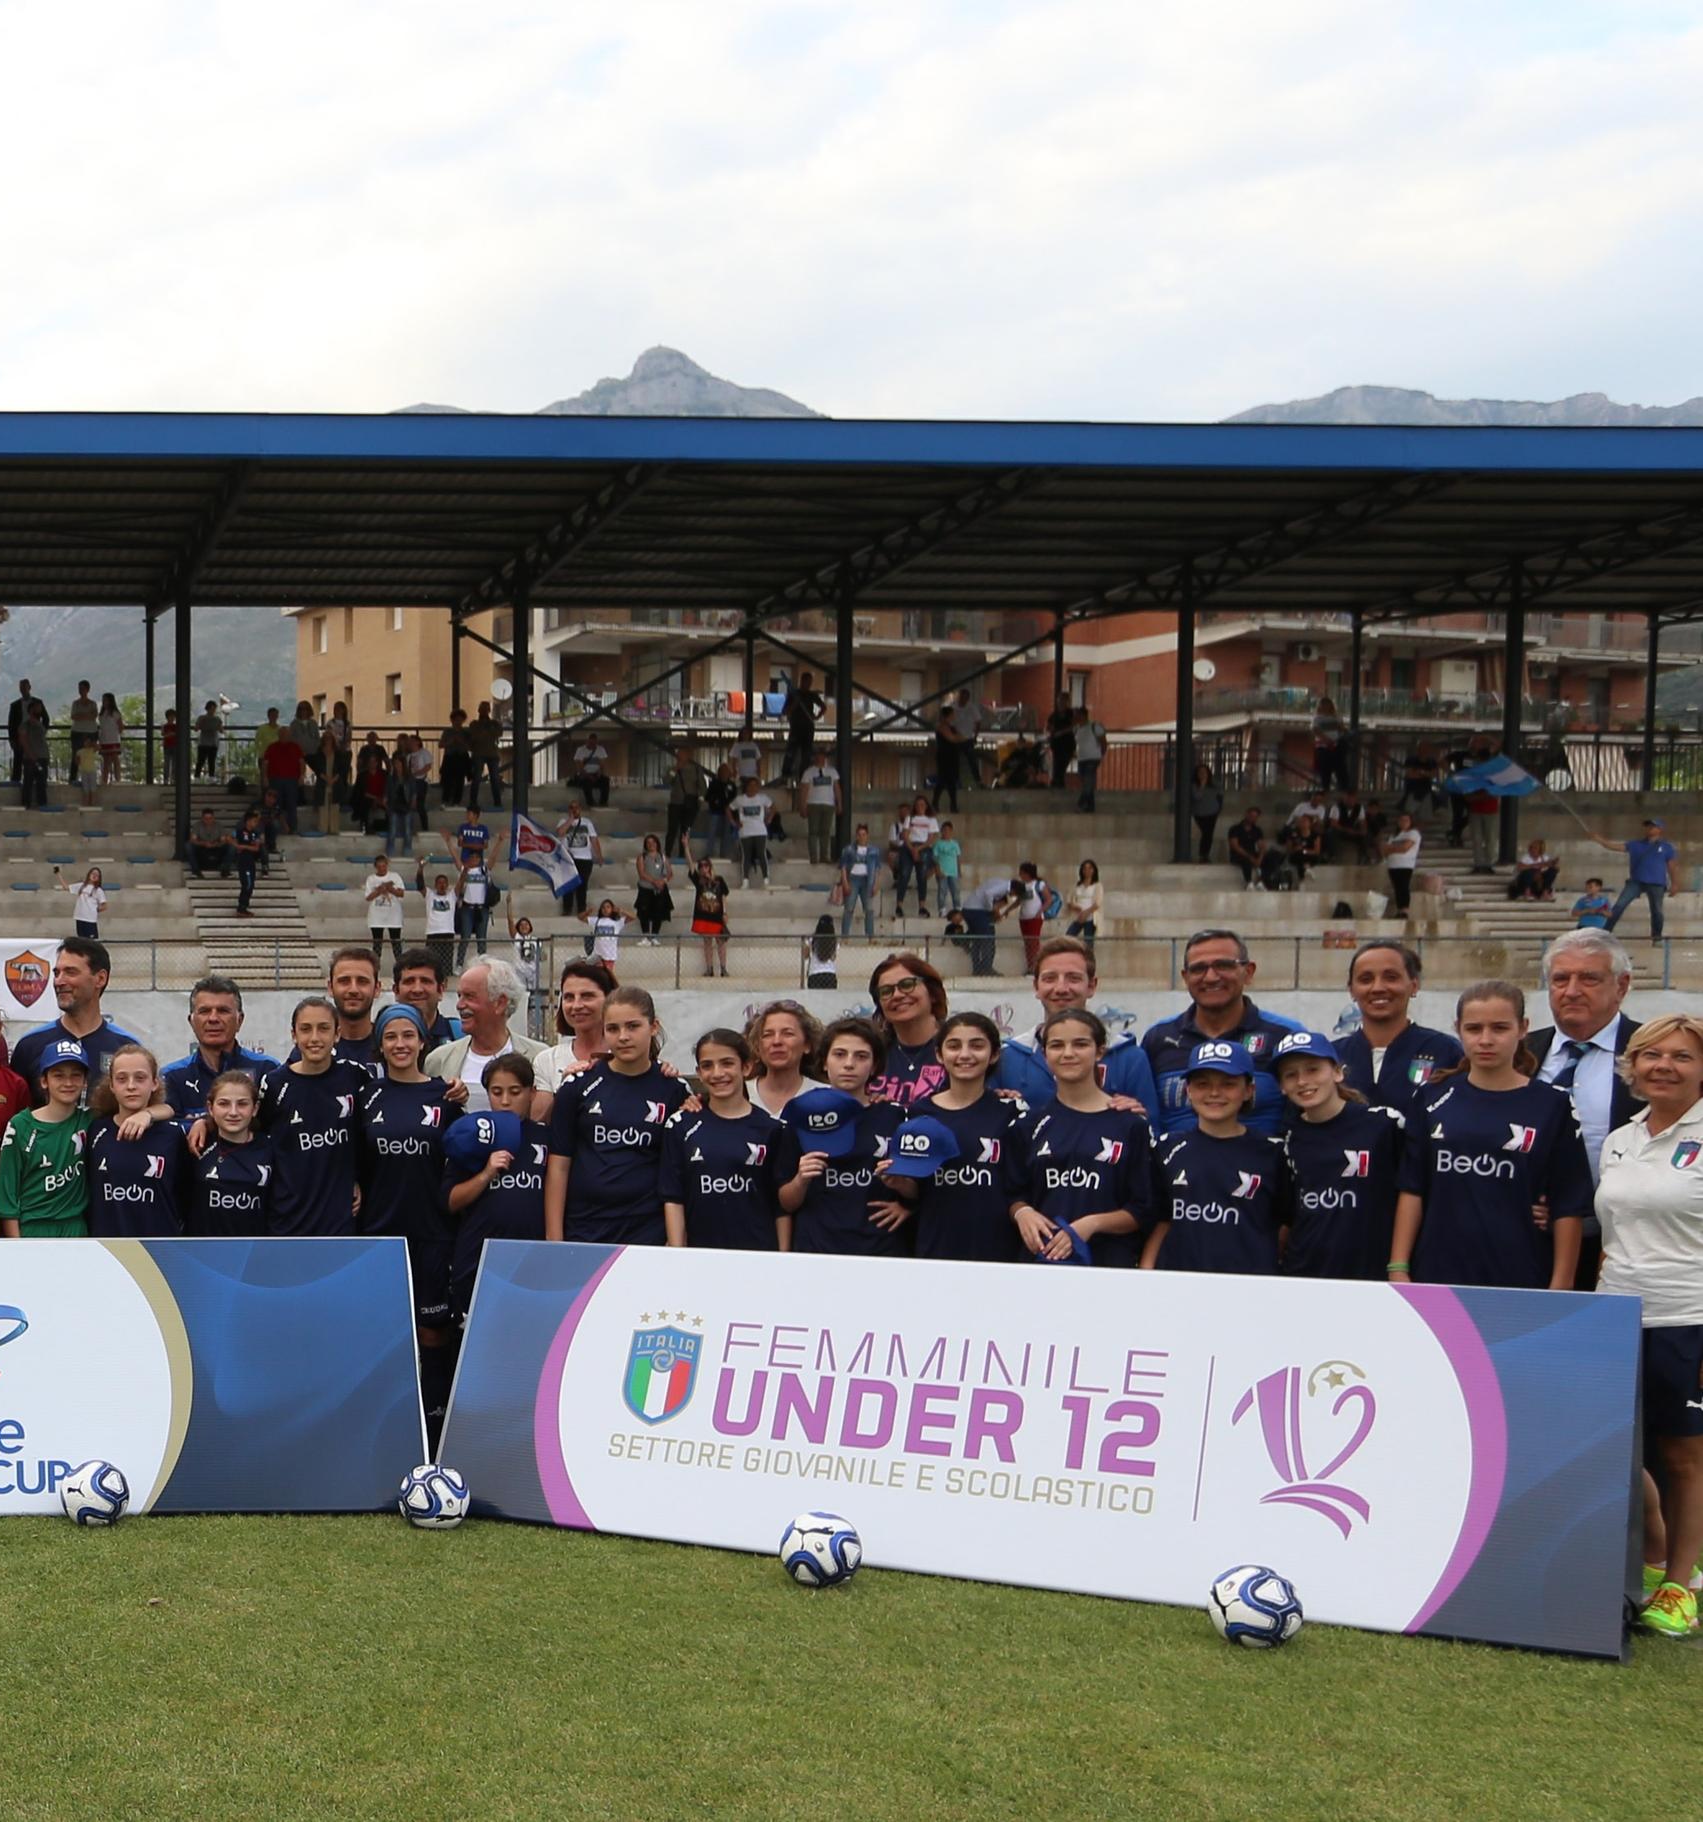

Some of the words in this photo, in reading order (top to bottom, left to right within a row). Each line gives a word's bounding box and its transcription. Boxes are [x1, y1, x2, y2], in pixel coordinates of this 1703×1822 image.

[299, 1128, 349, 1150] BeOn
[377, 1136, 430, 1156] BeOn
[593, 1124, 652, 1146] BeOn
[1437, 1149, 1515, 1179] BeOn
[825, 1167, 873, 1188] BeO
[1046, 1166, 1100, 1190] BeOn
[104, 1183, 155, 1204] BeOn
[1300, 1187, 1357, 1209] eOn
[1172, 1199, 1239, 1228] BeOn
[637, 1333, 695, 1354] ITALIA
[721, 1321, 1170, 1398] FEMMINILE
[711, 1366, 1025, 1464] UNDER
[1061, 1394, 1163, 1478] 12
[607, 1432, 736, 1470] SETTORE
[743, 1446, 907, 1489] GIOVANILE
[915, 1464, 936, 1492] E
[945, 1466, 1155, 1515] SCOLASTICO
